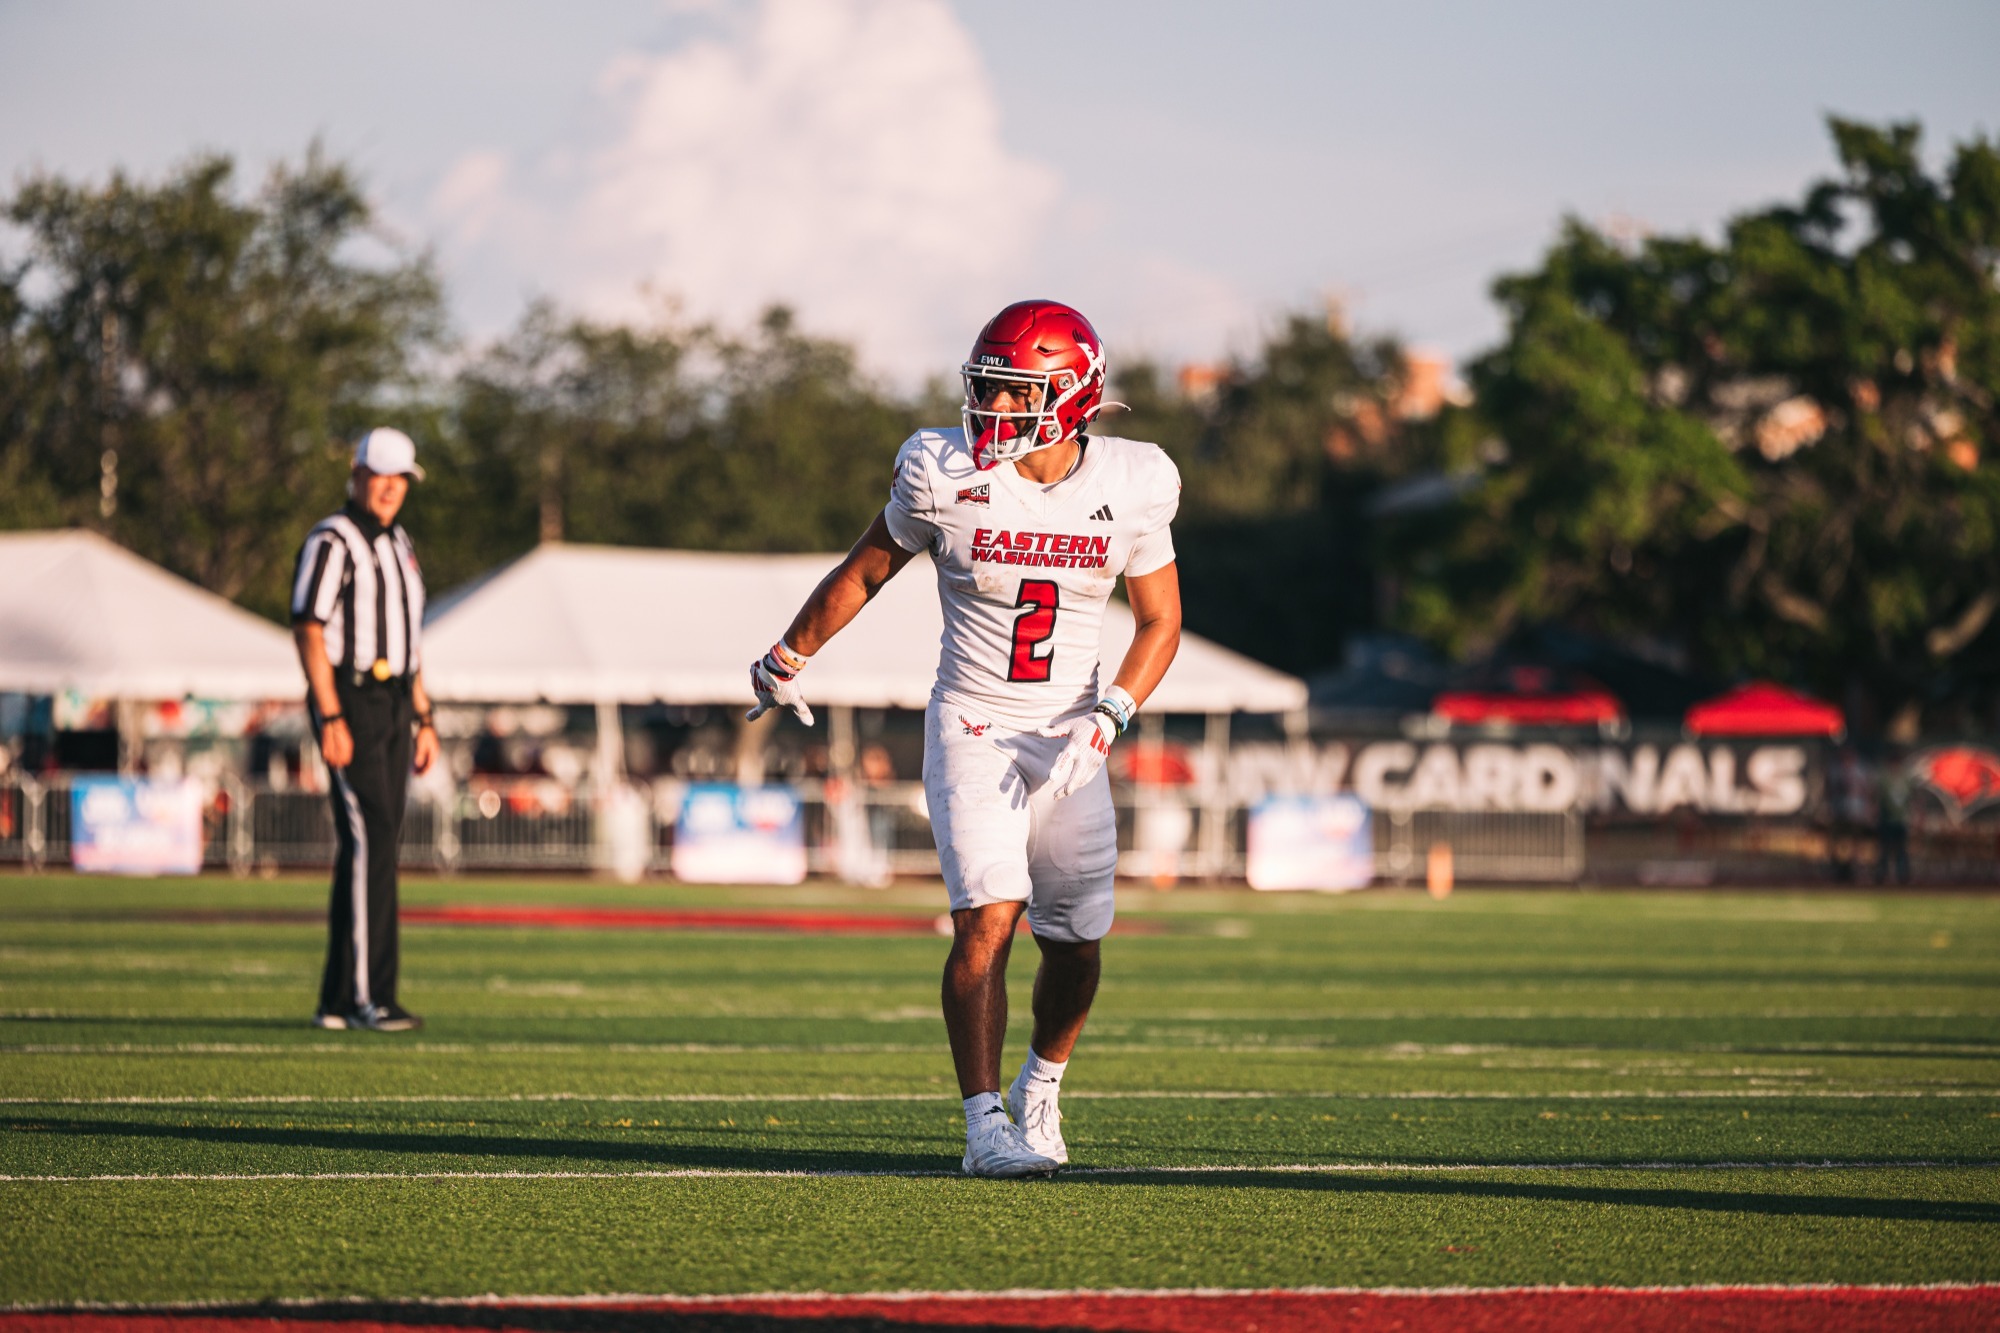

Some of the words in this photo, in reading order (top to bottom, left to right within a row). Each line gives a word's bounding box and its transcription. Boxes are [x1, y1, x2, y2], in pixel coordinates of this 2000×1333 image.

[980, 355, 1004, 367] EWU
[970, 484, 989, 497] SKY
[972, 528, 1112, 555] EASTERN
[970, 547, 1109, 568] WASHINGTON
[1007, 578, 1060, 682] 2
